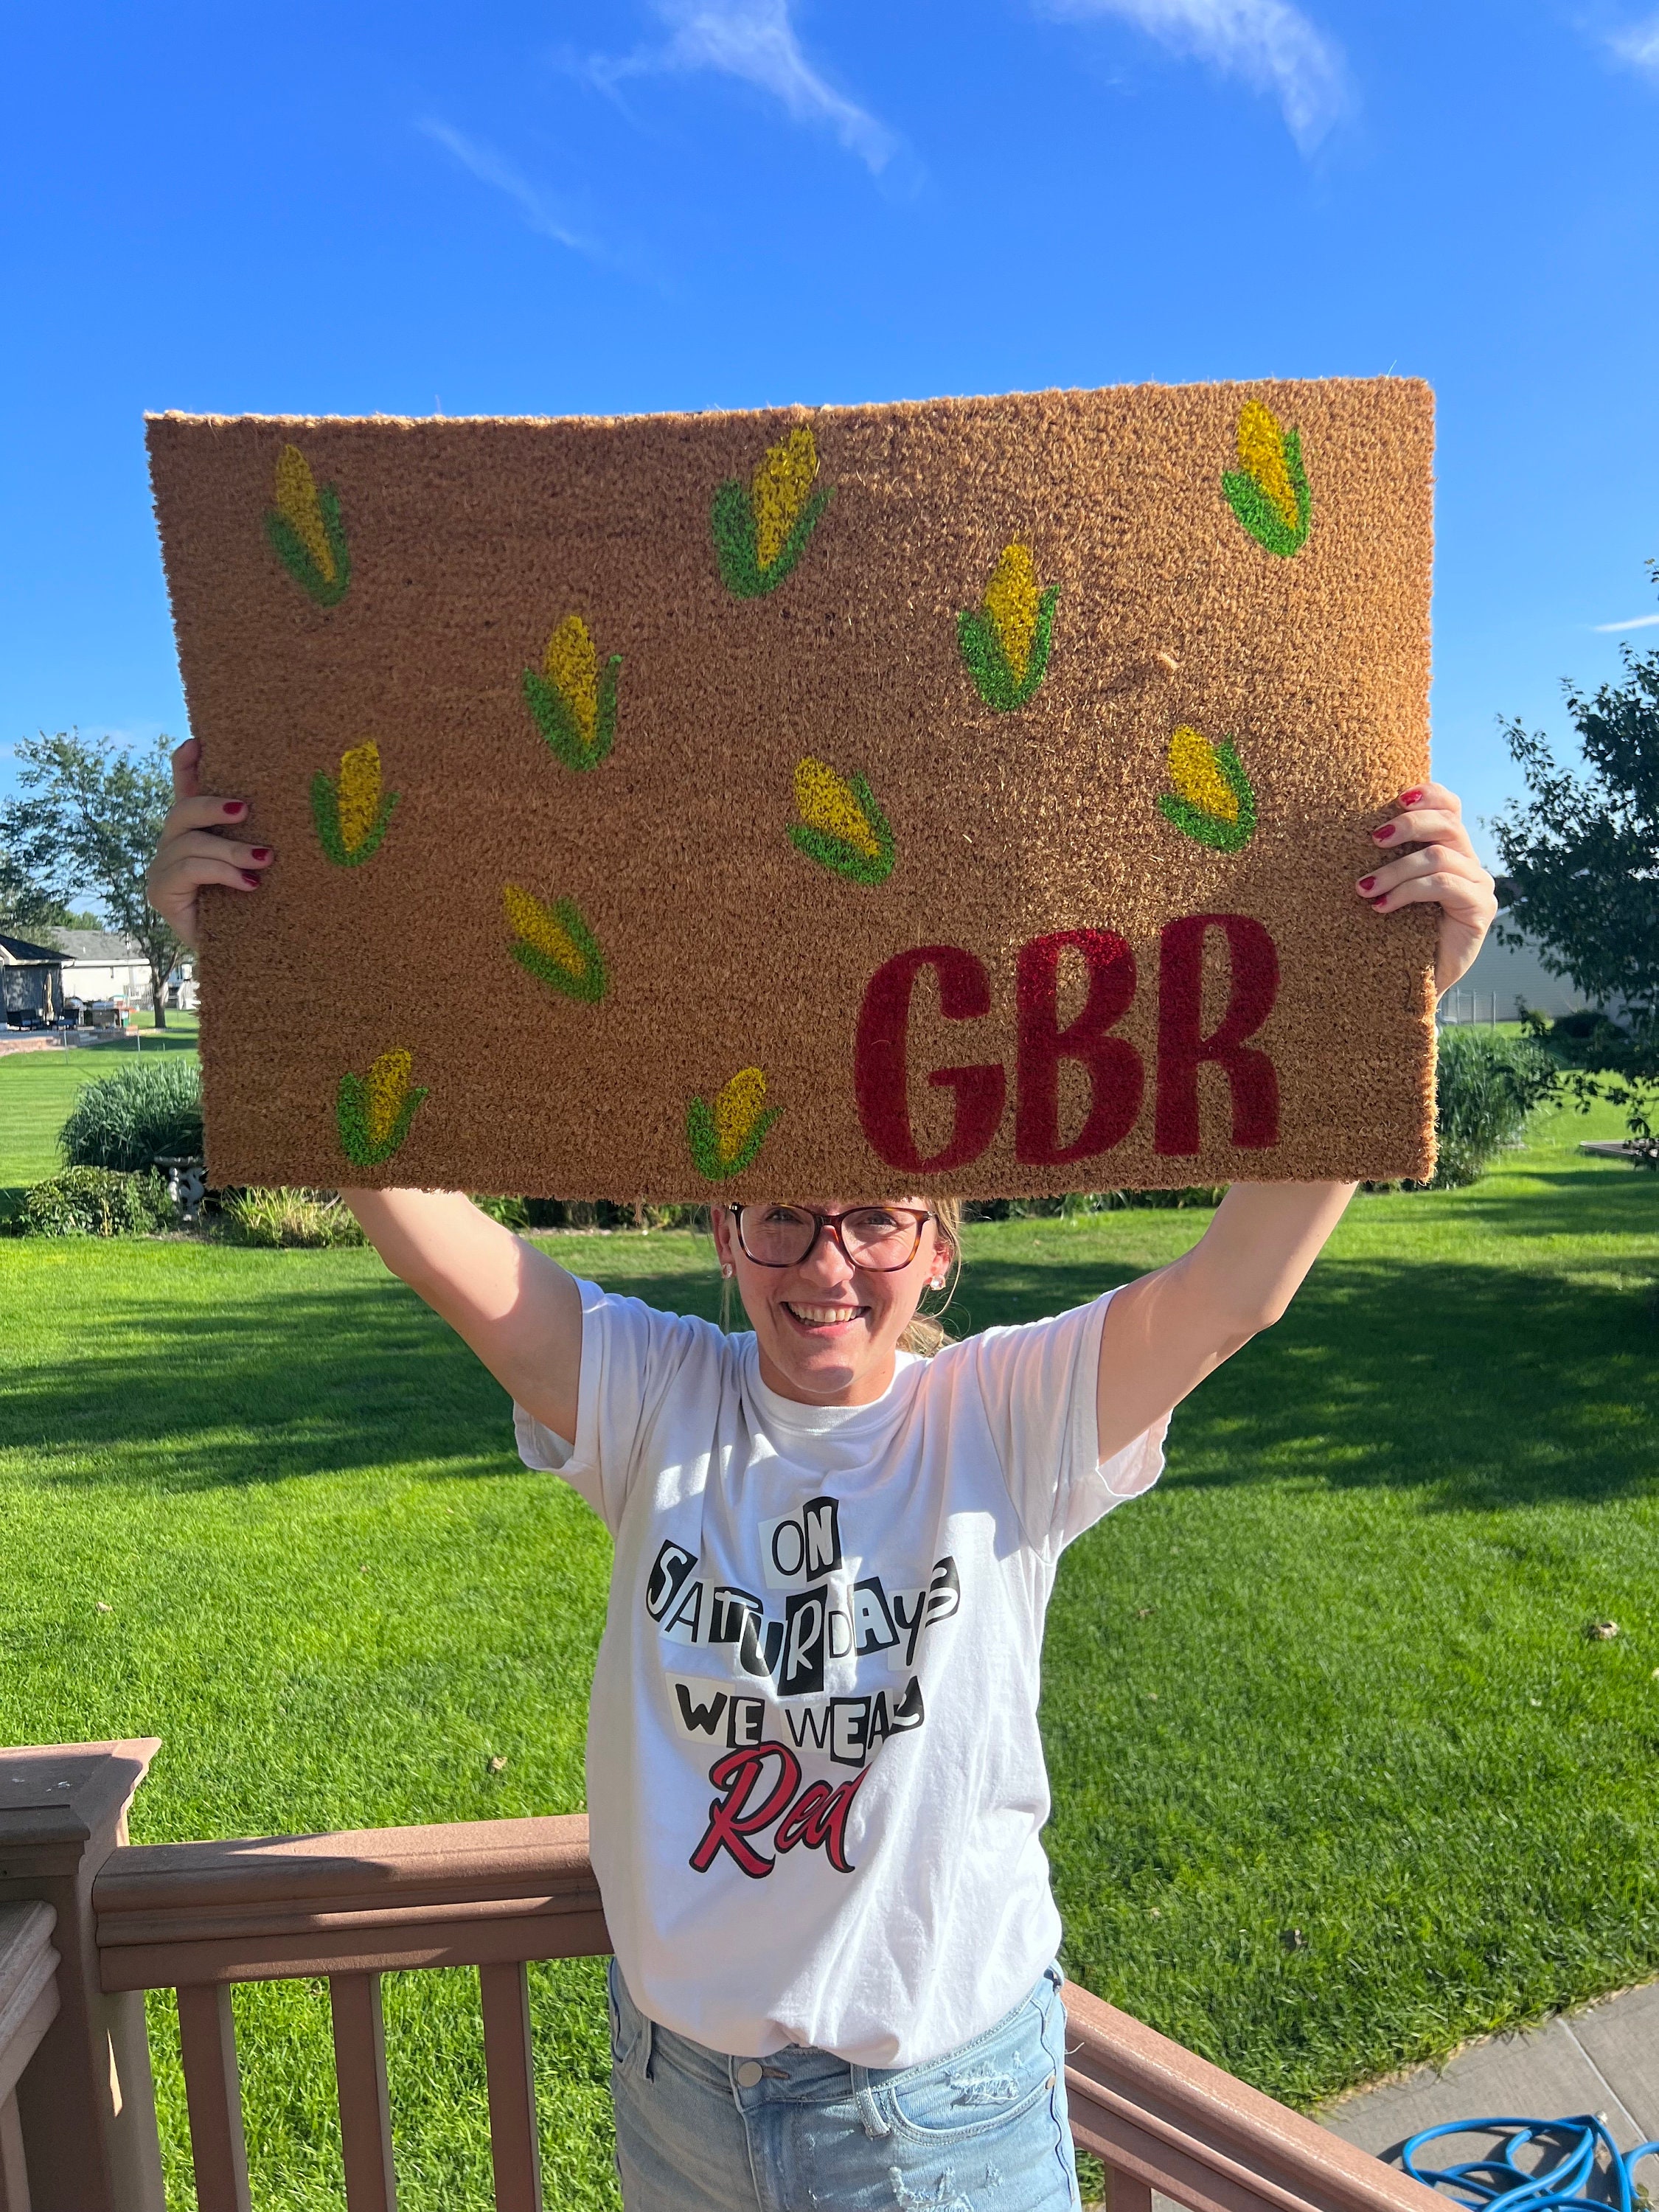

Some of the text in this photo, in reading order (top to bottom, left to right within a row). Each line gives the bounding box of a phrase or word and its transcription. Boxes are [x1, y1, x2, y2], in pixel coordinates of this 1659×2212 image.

[855, 914, 1280, 1174] GBR
[771, 1498, 841, 1580] ON
[675, 1684, 765, 1748] WE
